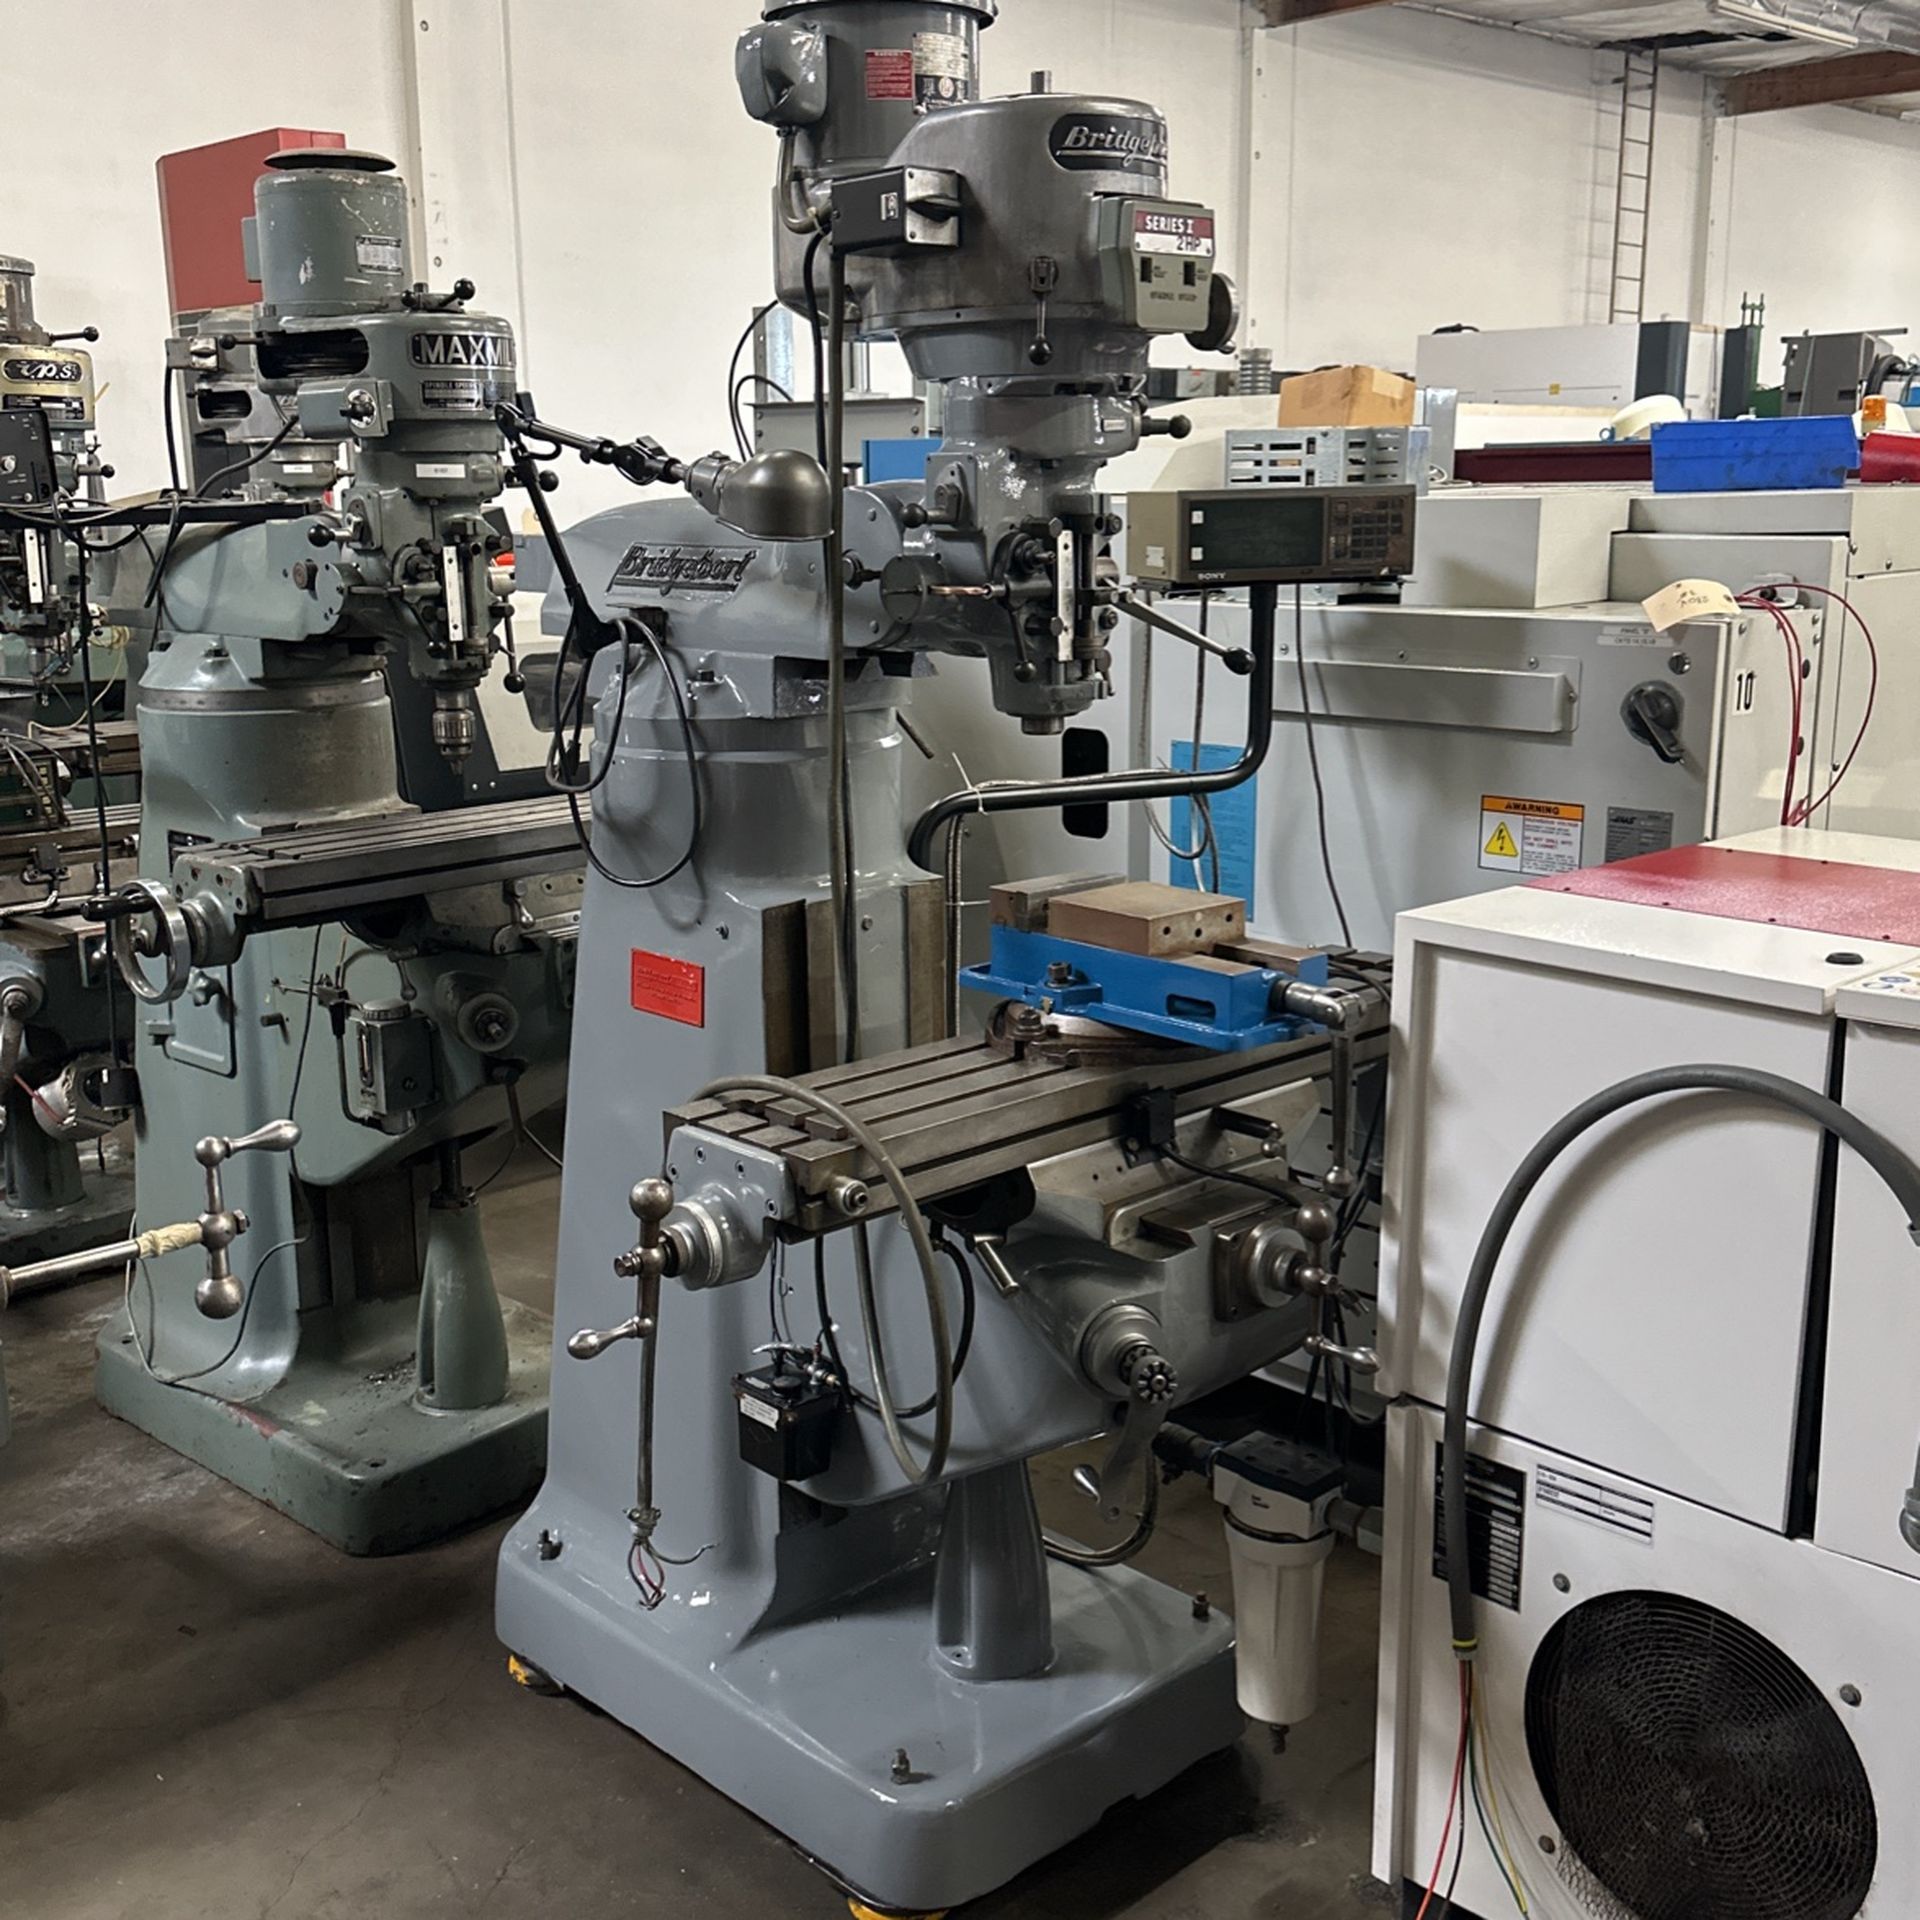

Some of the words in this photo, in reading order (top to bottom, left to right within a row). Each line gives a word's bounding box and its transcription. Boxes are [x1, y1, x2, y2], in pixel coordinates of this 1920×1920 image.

[1145, 215, 1184, 233] SERIES
[606, 546, 758, 597] Bridgeport
[1198, 572, 1226, 580] SONY
[1737, 671, 1756, 711] 10
[1512, 802, 1560, 815] WARNING
